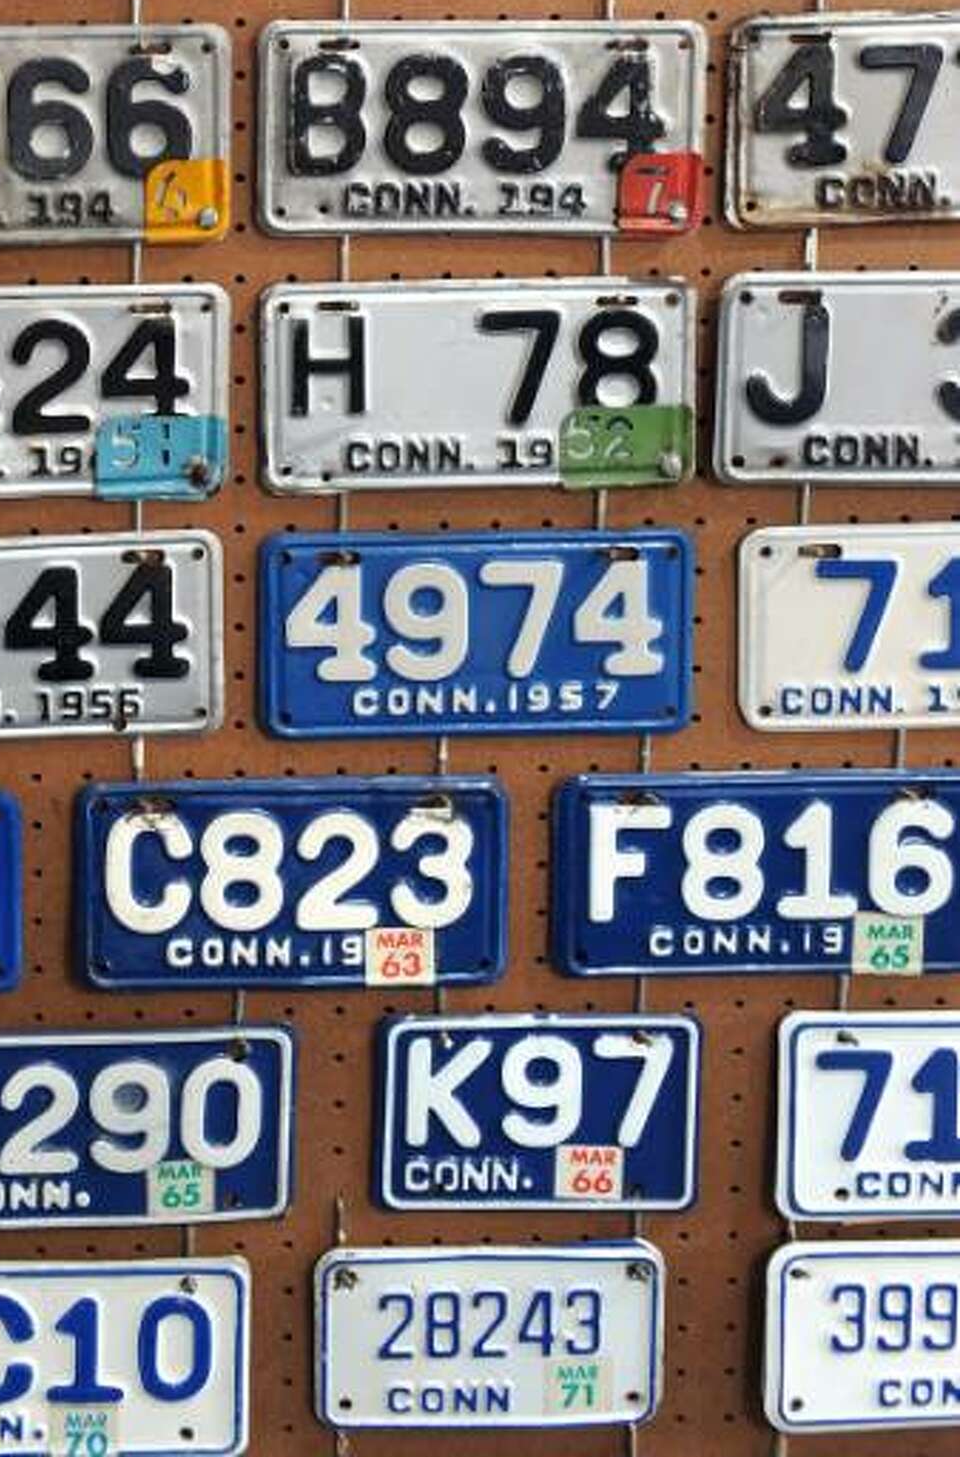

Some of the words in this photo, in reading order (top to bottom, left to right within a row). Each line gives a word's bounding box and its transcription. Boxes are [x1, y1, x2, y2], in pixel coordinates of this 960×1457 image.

[753, 44, 960, 167] 47
[25, 192, 114, 225] 194
[342, 183, 475, 218] CONN.
[498, 183, 587, 215] 194
[288, 315, 365, 417] H
[474, 309, 660, 426] 78
[746, 302, 831, 426] J
[28, 446, 96, 480] 19
[345, 441, 475, 472] CONN.
[499, 437, 554, 470] 19
[802, 434, 933, 466] CONN.
[285, 557, 664, 681] 4974
[37, 688, 141, 721] 1956
[780, 685, 905, 717] CONN.
[105, 811, 474, 933] C823
[589, 798, 955, 922] F816
[375, 933, 423, 948] MAR
[865, 925, 914, 941] MAR
[380, 953, 423, 978] 63
[869, 946, 910, 970] 65
[404, 1034, 674, 1148] K97
[405, 1158, 533, 1191] CONN.
[570, 1150, 615, 1167] MAR
[161, 1184, 200, 1209] 65
[571, 1169, 614, 1194] 66
[377, 1289, 603, 1360] 28243
[557, 1365, 599, 1382] MAR
[386, 1387, 512, 1412] CONN
[561, 1383, 595, 1407] 71
[64, 1412, 108, 1428] MAR
[66, 1432, 108, 1457] 70
